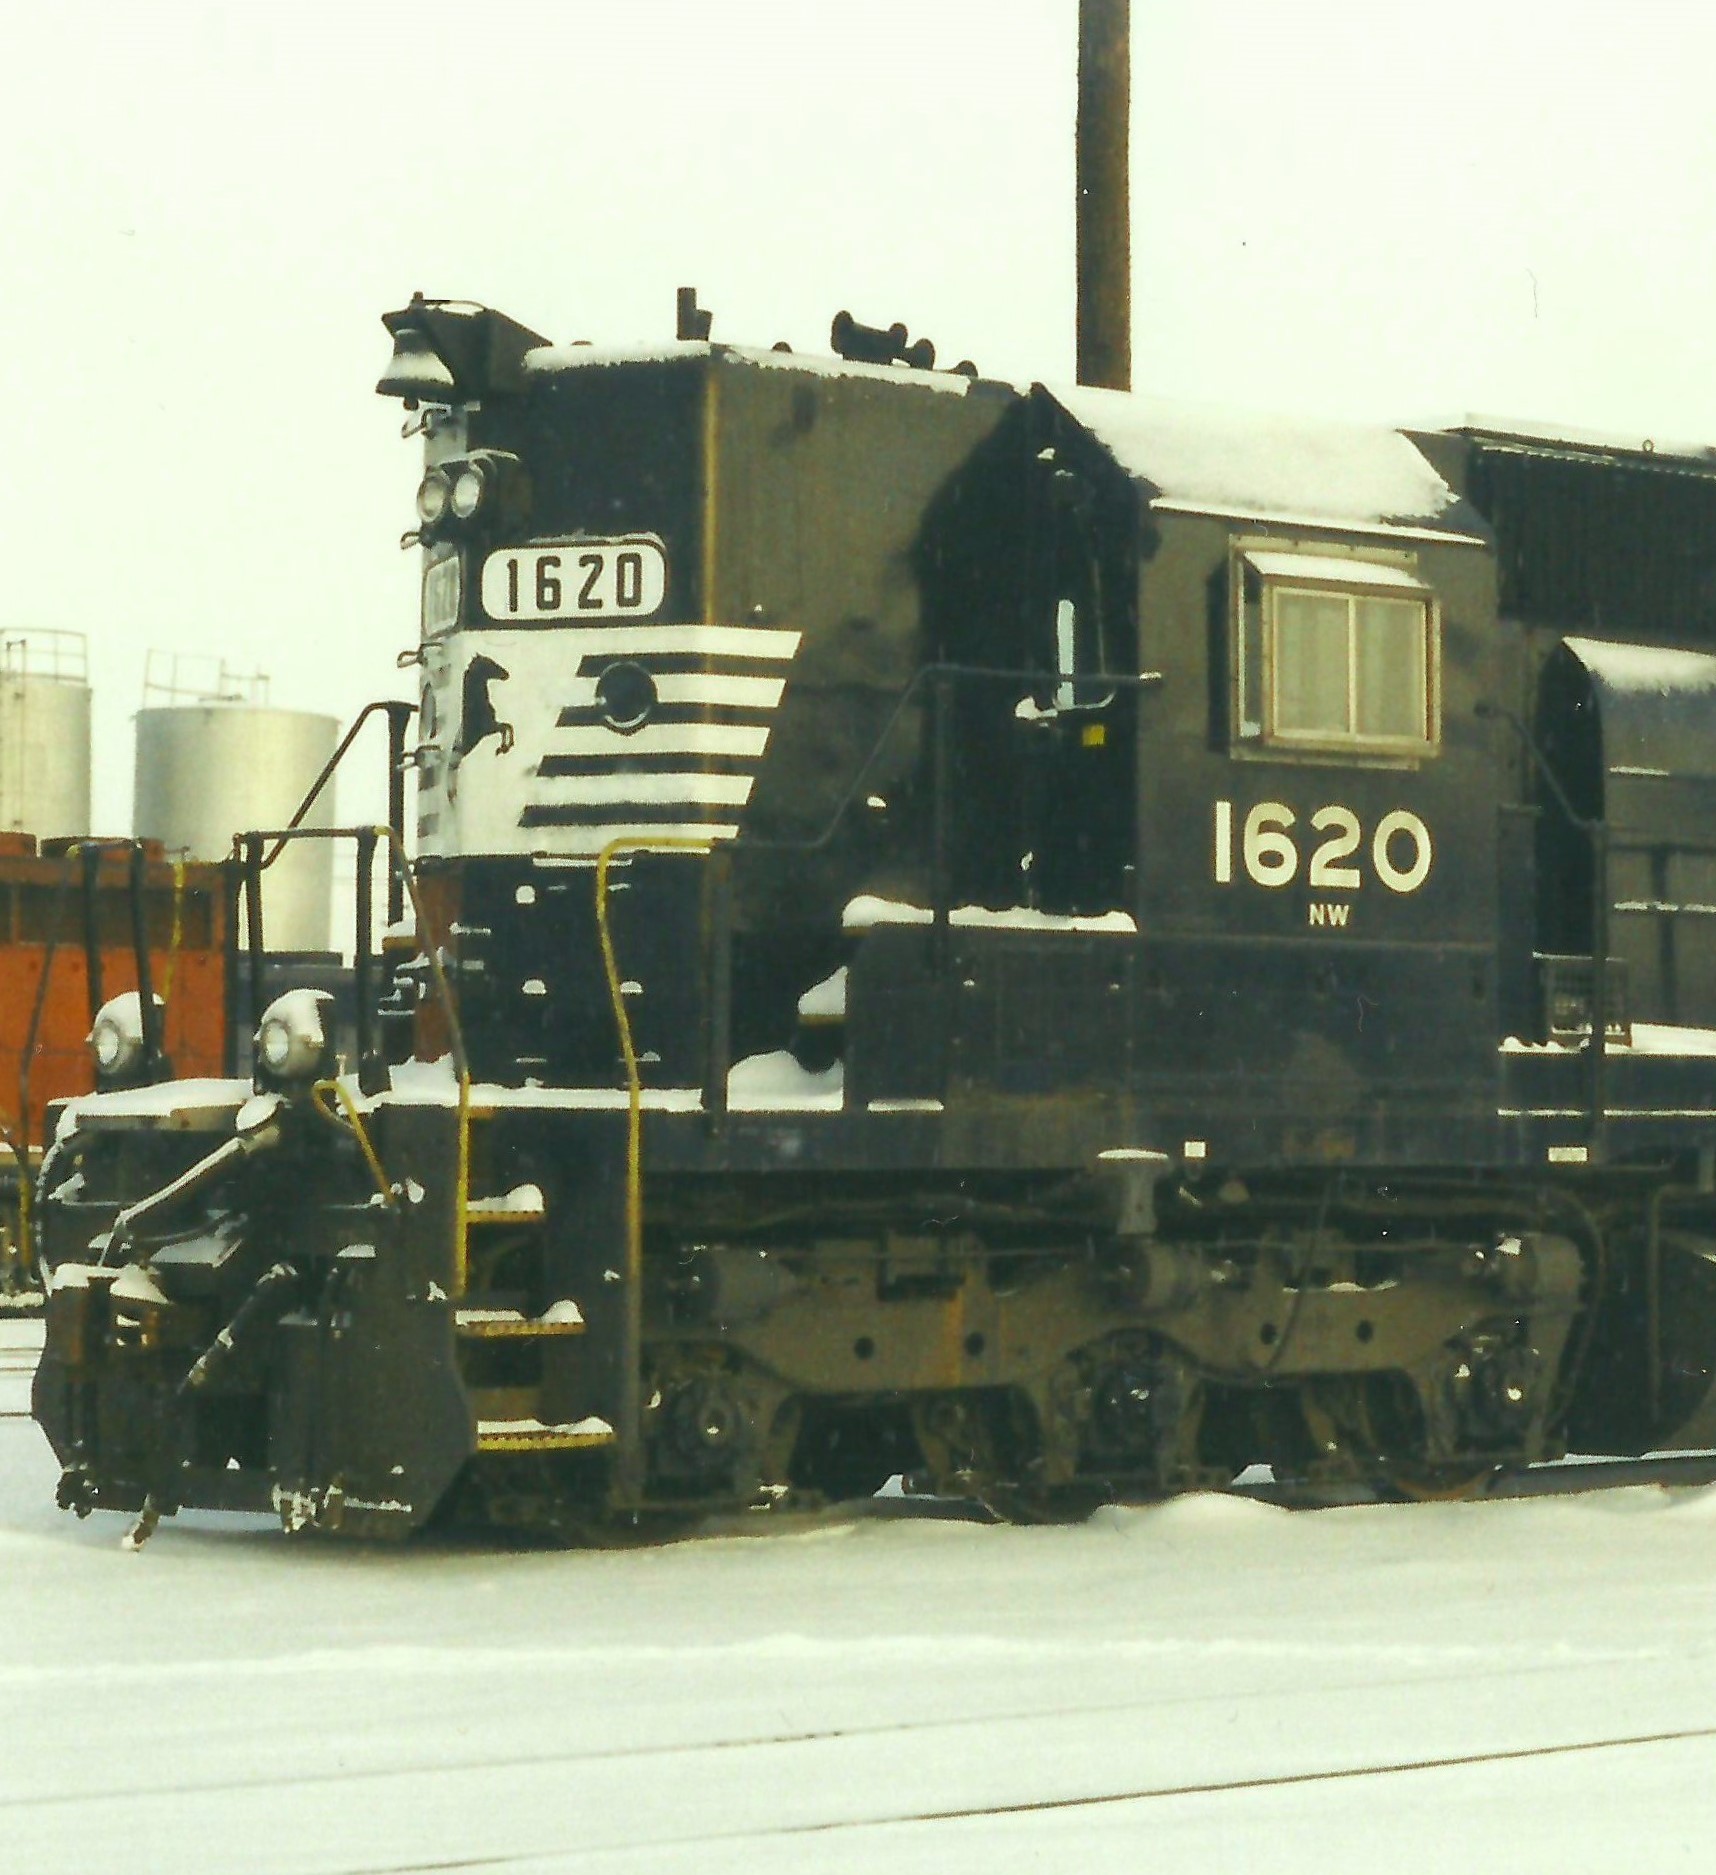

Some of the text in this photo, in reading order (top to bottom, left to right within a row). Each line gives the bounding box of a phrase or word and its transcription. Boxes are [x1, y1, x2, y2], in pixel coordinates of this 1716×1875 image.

[507, 552, 643, 613] 1620
[1214, 800, 1432, 893] 1620
[1308, 903, 1350, 927] NW
